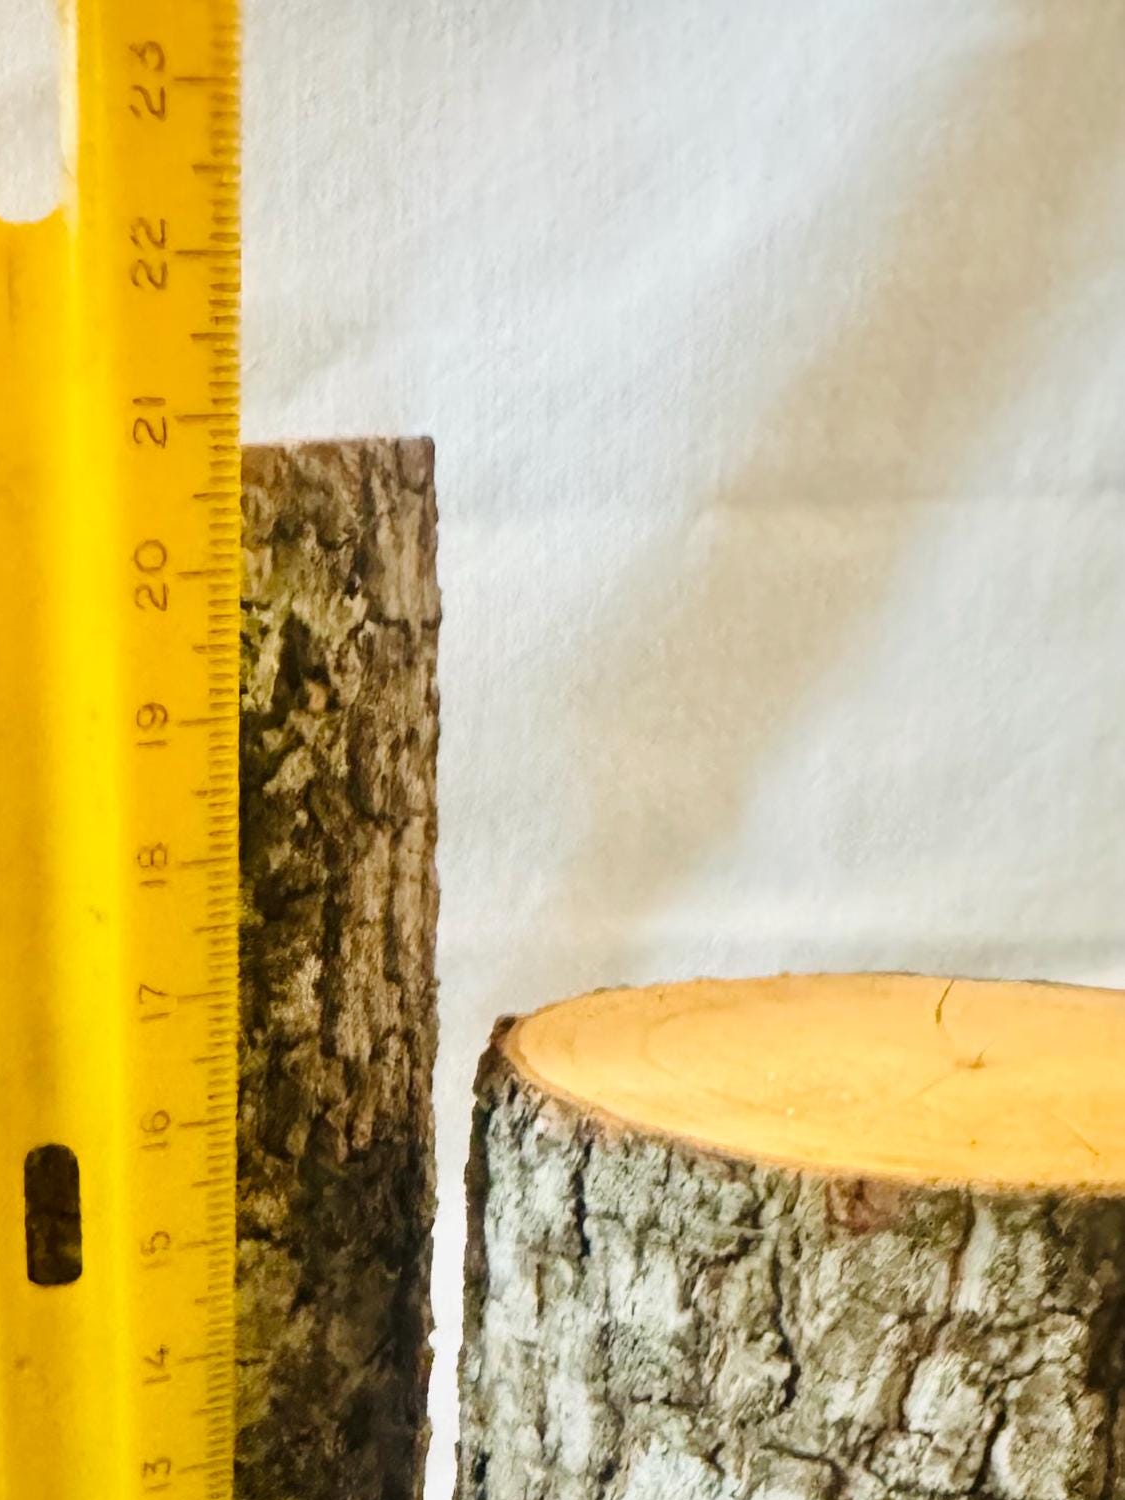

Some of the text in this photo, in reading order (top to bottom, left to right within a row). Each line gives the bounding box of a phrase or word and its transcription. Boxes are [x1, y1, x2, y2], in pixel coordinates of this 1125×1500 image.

[128, 40, 166, 122] 23
[130, 217, 167, 291] 22
[132, 396, 167, 448] 21
[133, 539, 168, 612] 20
[136, 702, 169, 747] 19
[136, 842, 168, 887] 18
[138, 983, 172, 1022] 17
[139, 1109, 171, 1151] 16
[139, 1230, 171, 1270] 15
[143, 1344, 172, 1386] 14
[141, 1457, 172, 1494] 13
